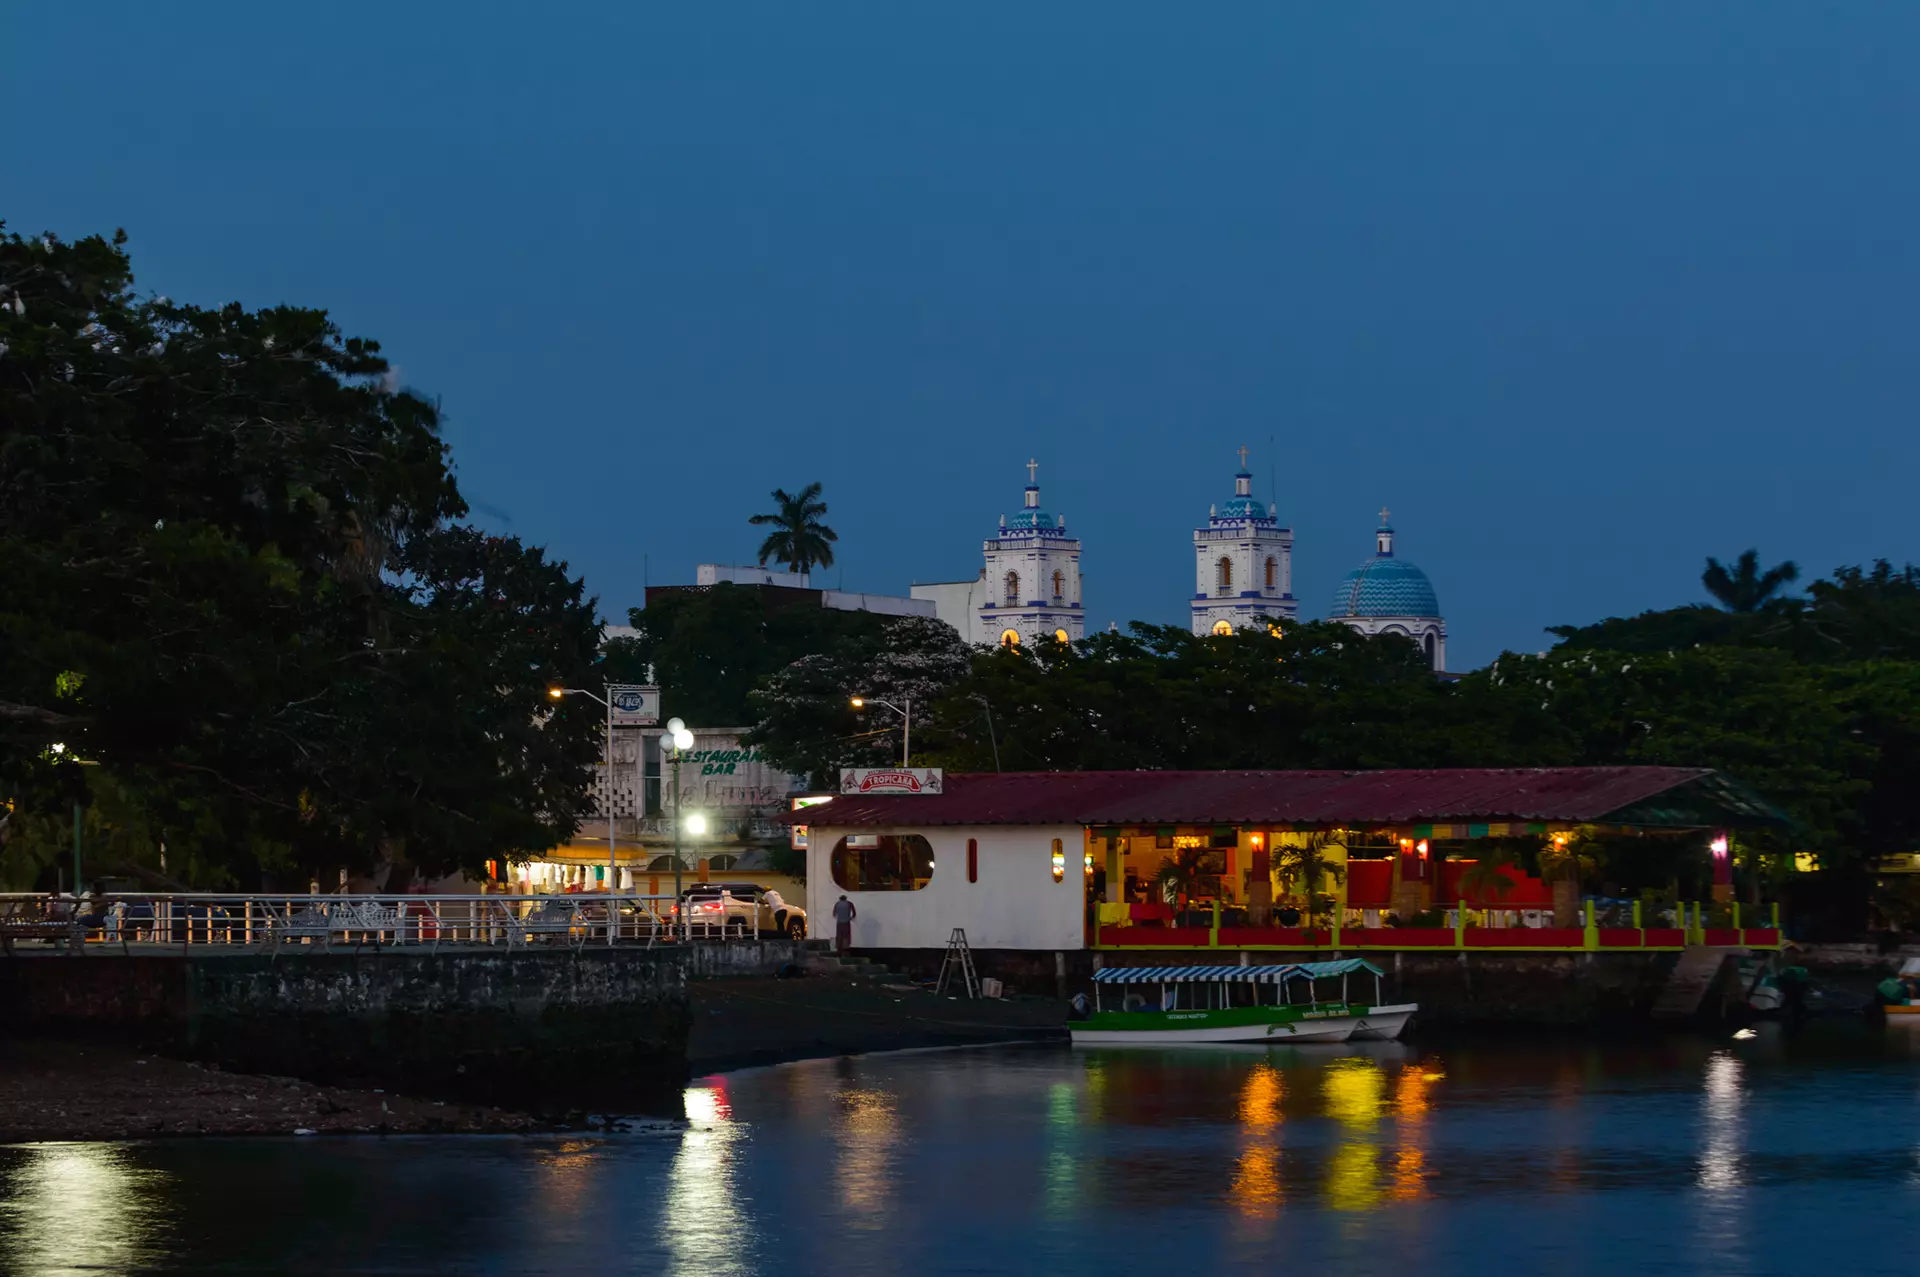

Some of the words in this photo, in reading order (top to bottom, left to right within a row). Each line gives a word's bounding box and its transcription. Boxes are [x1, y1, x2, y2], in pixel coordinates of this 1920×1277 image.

[678, 749, 761, 763] ESTAURAN
[701, 763, 736, 775] BAR
[868, 775, 913, 786] TROPICANA
